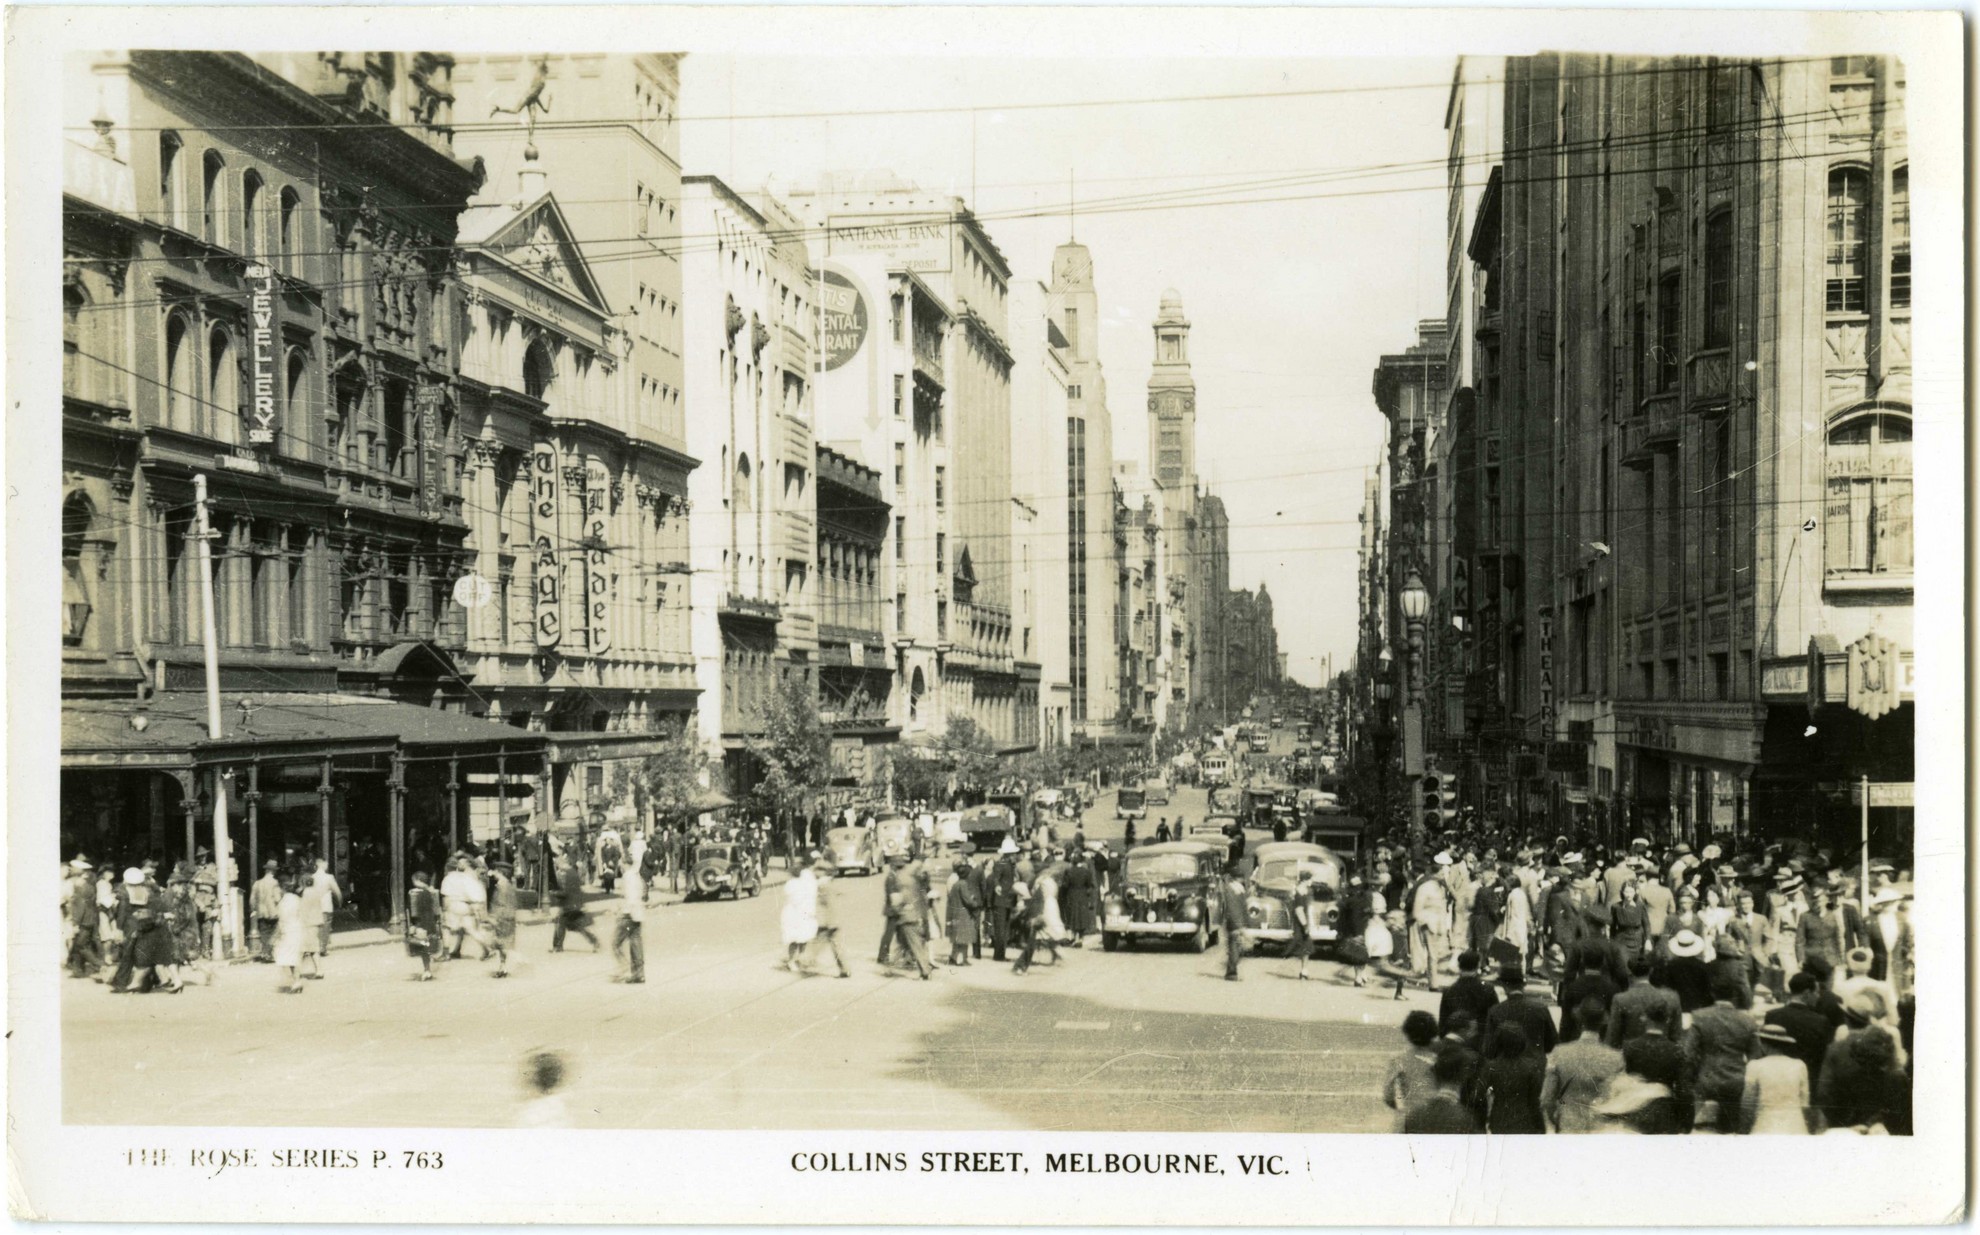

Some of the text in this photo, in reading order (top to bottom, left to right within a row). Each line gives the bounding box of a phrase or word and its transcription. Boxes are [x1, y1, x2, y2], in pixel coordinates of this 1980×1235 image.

[835, 224, 945, 242] NATIONAL BANK
[253, 278, 274, 430] JEWELLERY
[536, 535, 558, 637] Age
[587, 487, 606, 646] Leader
[1540, 621, 1552, 739] THEATRE
